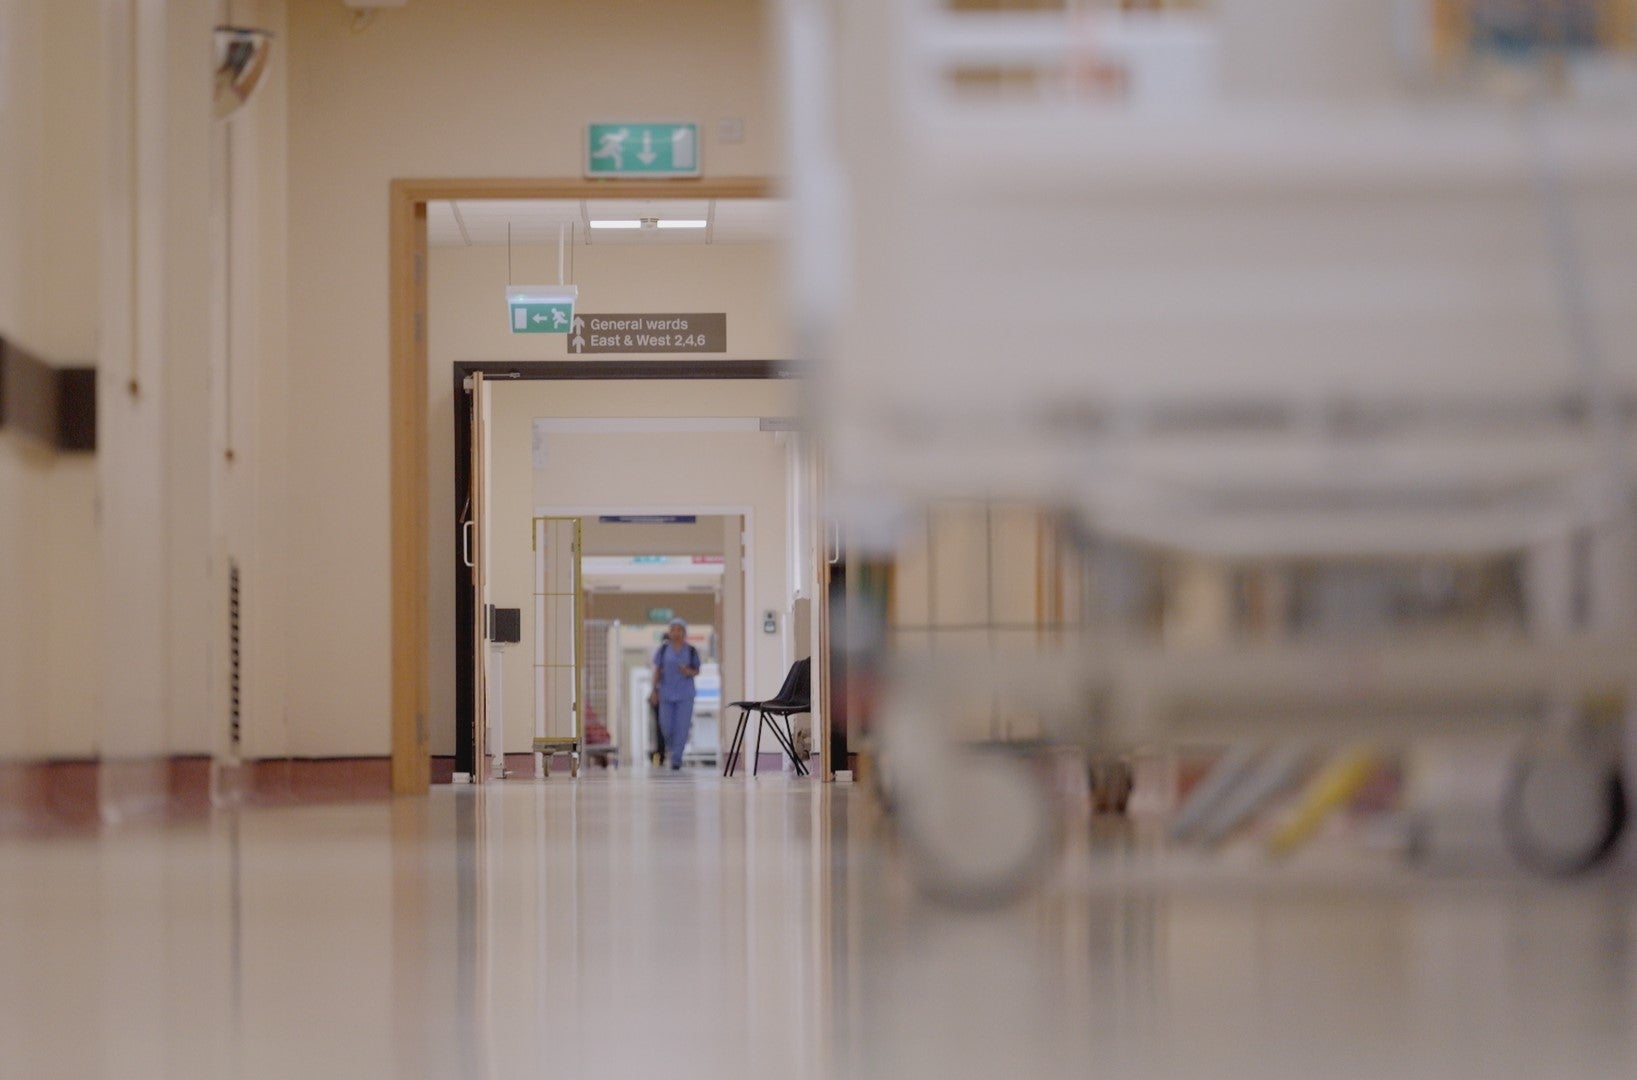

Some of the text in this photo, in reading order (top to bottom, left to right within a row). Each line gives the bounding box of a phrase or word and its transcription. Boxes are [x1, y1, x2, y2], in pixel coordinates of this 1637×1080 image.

[591, 318, 688, 330] General wards
[591, 334, 620, 347] East
[624, 334, 633, 347] &
[636, 334, 671, 347] West
